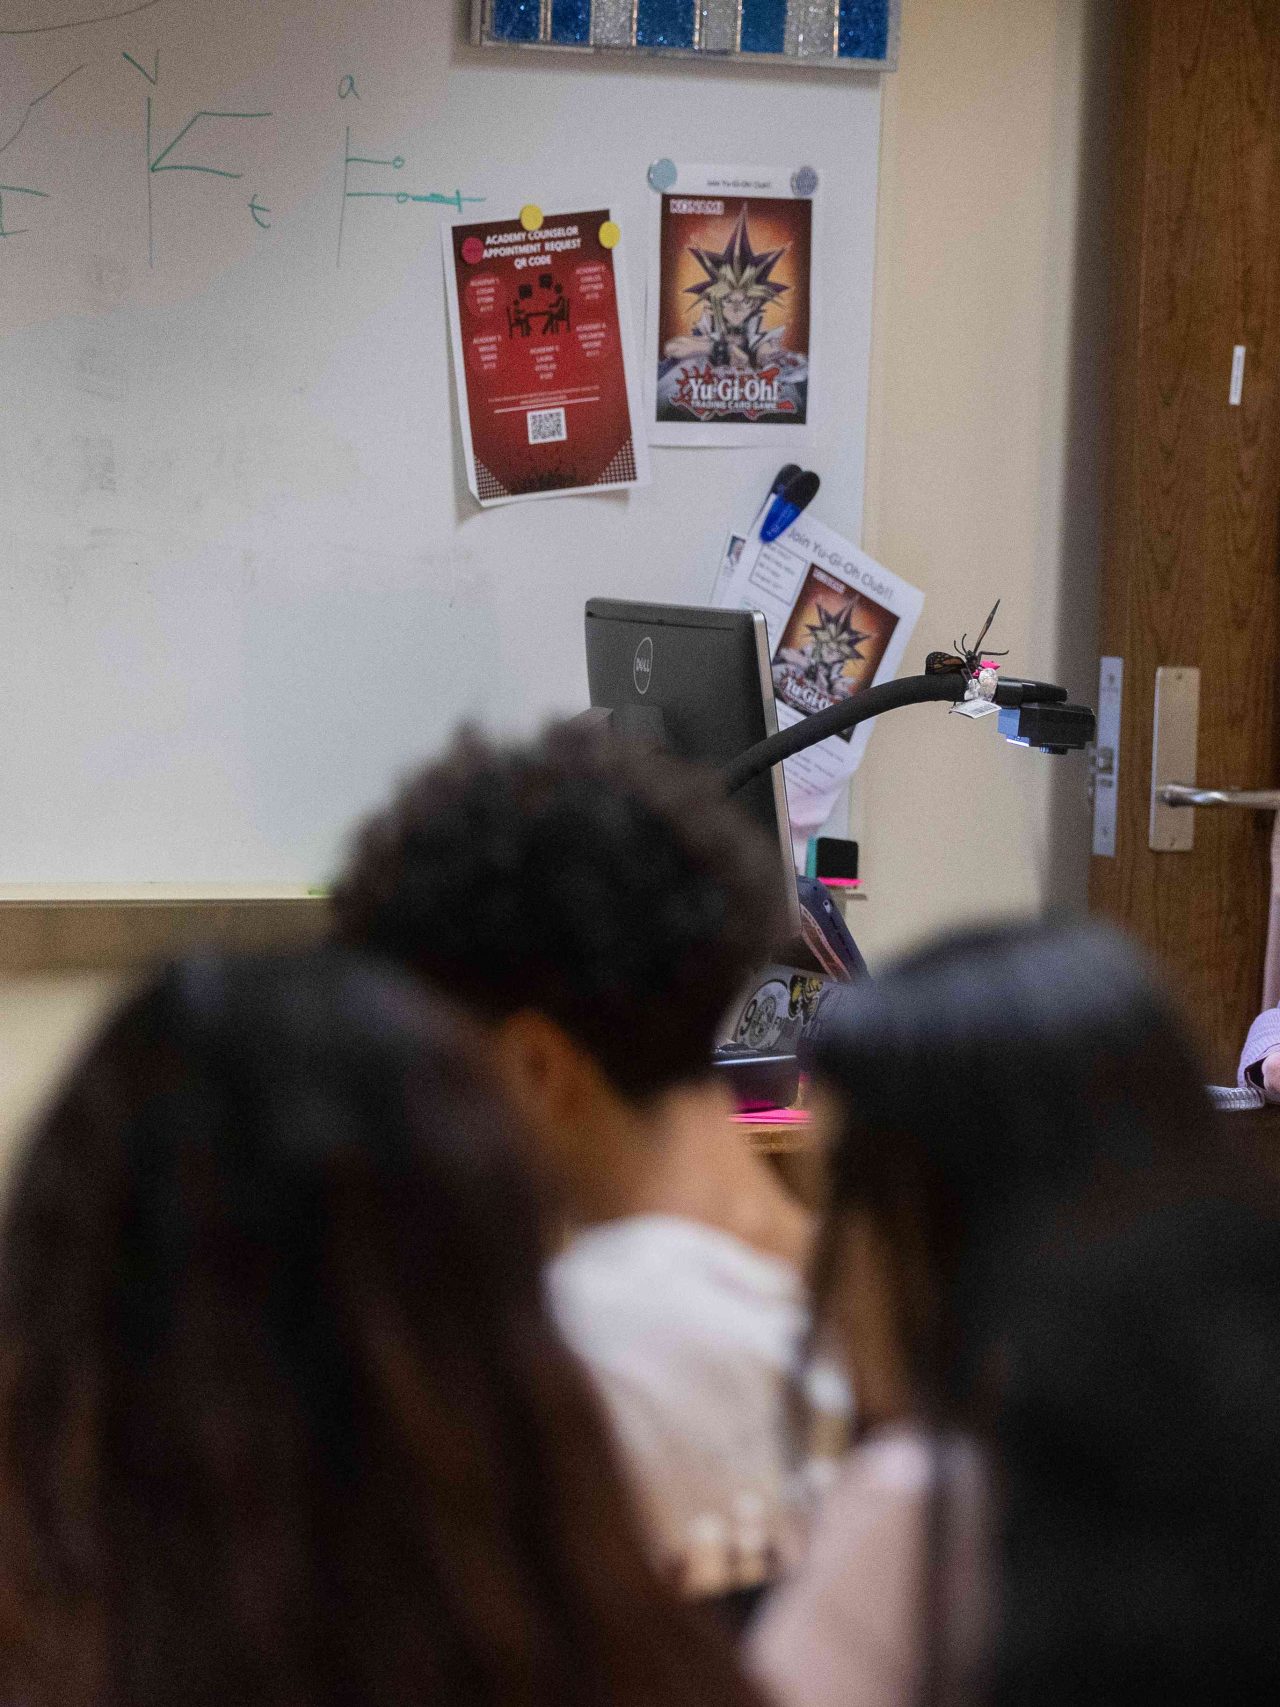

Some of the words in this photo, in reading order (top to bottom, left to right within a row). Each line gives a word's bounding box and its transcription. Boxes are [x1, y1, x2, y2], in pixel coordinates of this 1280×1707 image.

[485, 231, 526, 246] ACADEMY
[527, 224, 579, 241] COUNSELOR
[482, 243, 541, 259] APPOINTMENT
[544, 238, 582, 253] REQUEST
[514, 257, 527, 270] QR
[528, 255, 552, 267] CODE
[690, 376, 779, 402] Yu-Gi-Oh!
[788, 529, 811, 549] Join
[636, 657, 650, 673] DELL
